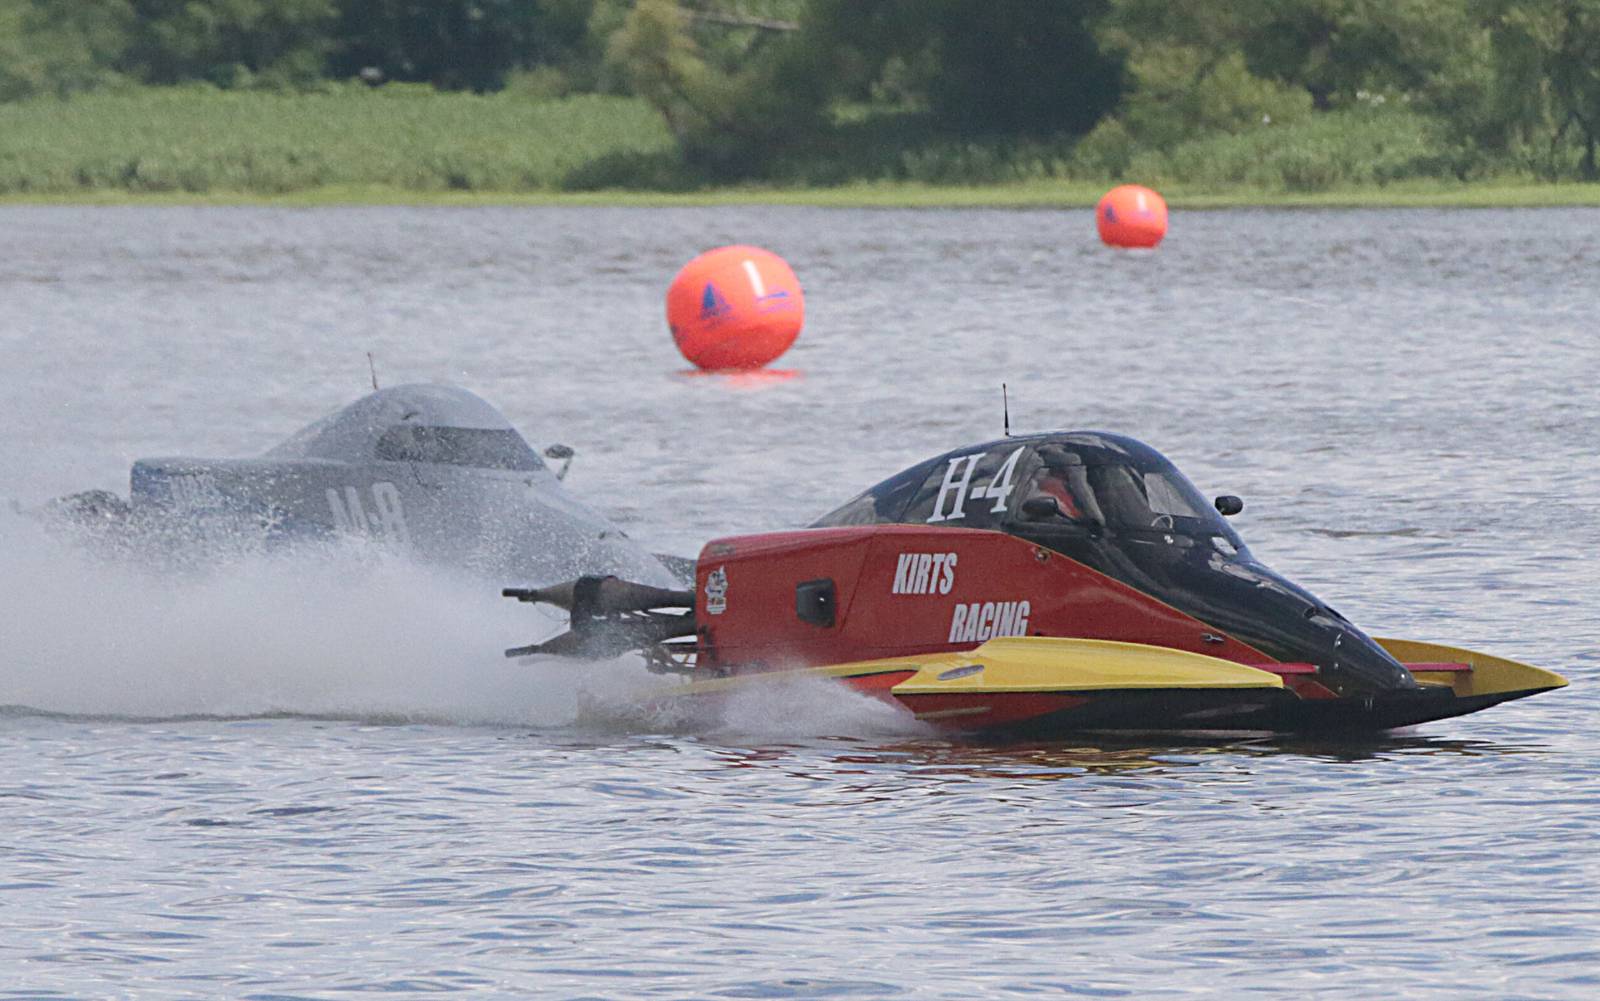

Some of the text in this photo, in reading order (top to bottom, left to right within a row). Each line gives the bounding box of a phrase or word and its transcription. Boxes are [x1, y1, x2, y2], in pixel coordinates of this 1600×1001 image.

[927, 446, 1026, 523] H-4
[892, 553, 958, 595] KIRTS
[948, 601, 1031, 643] RACING
